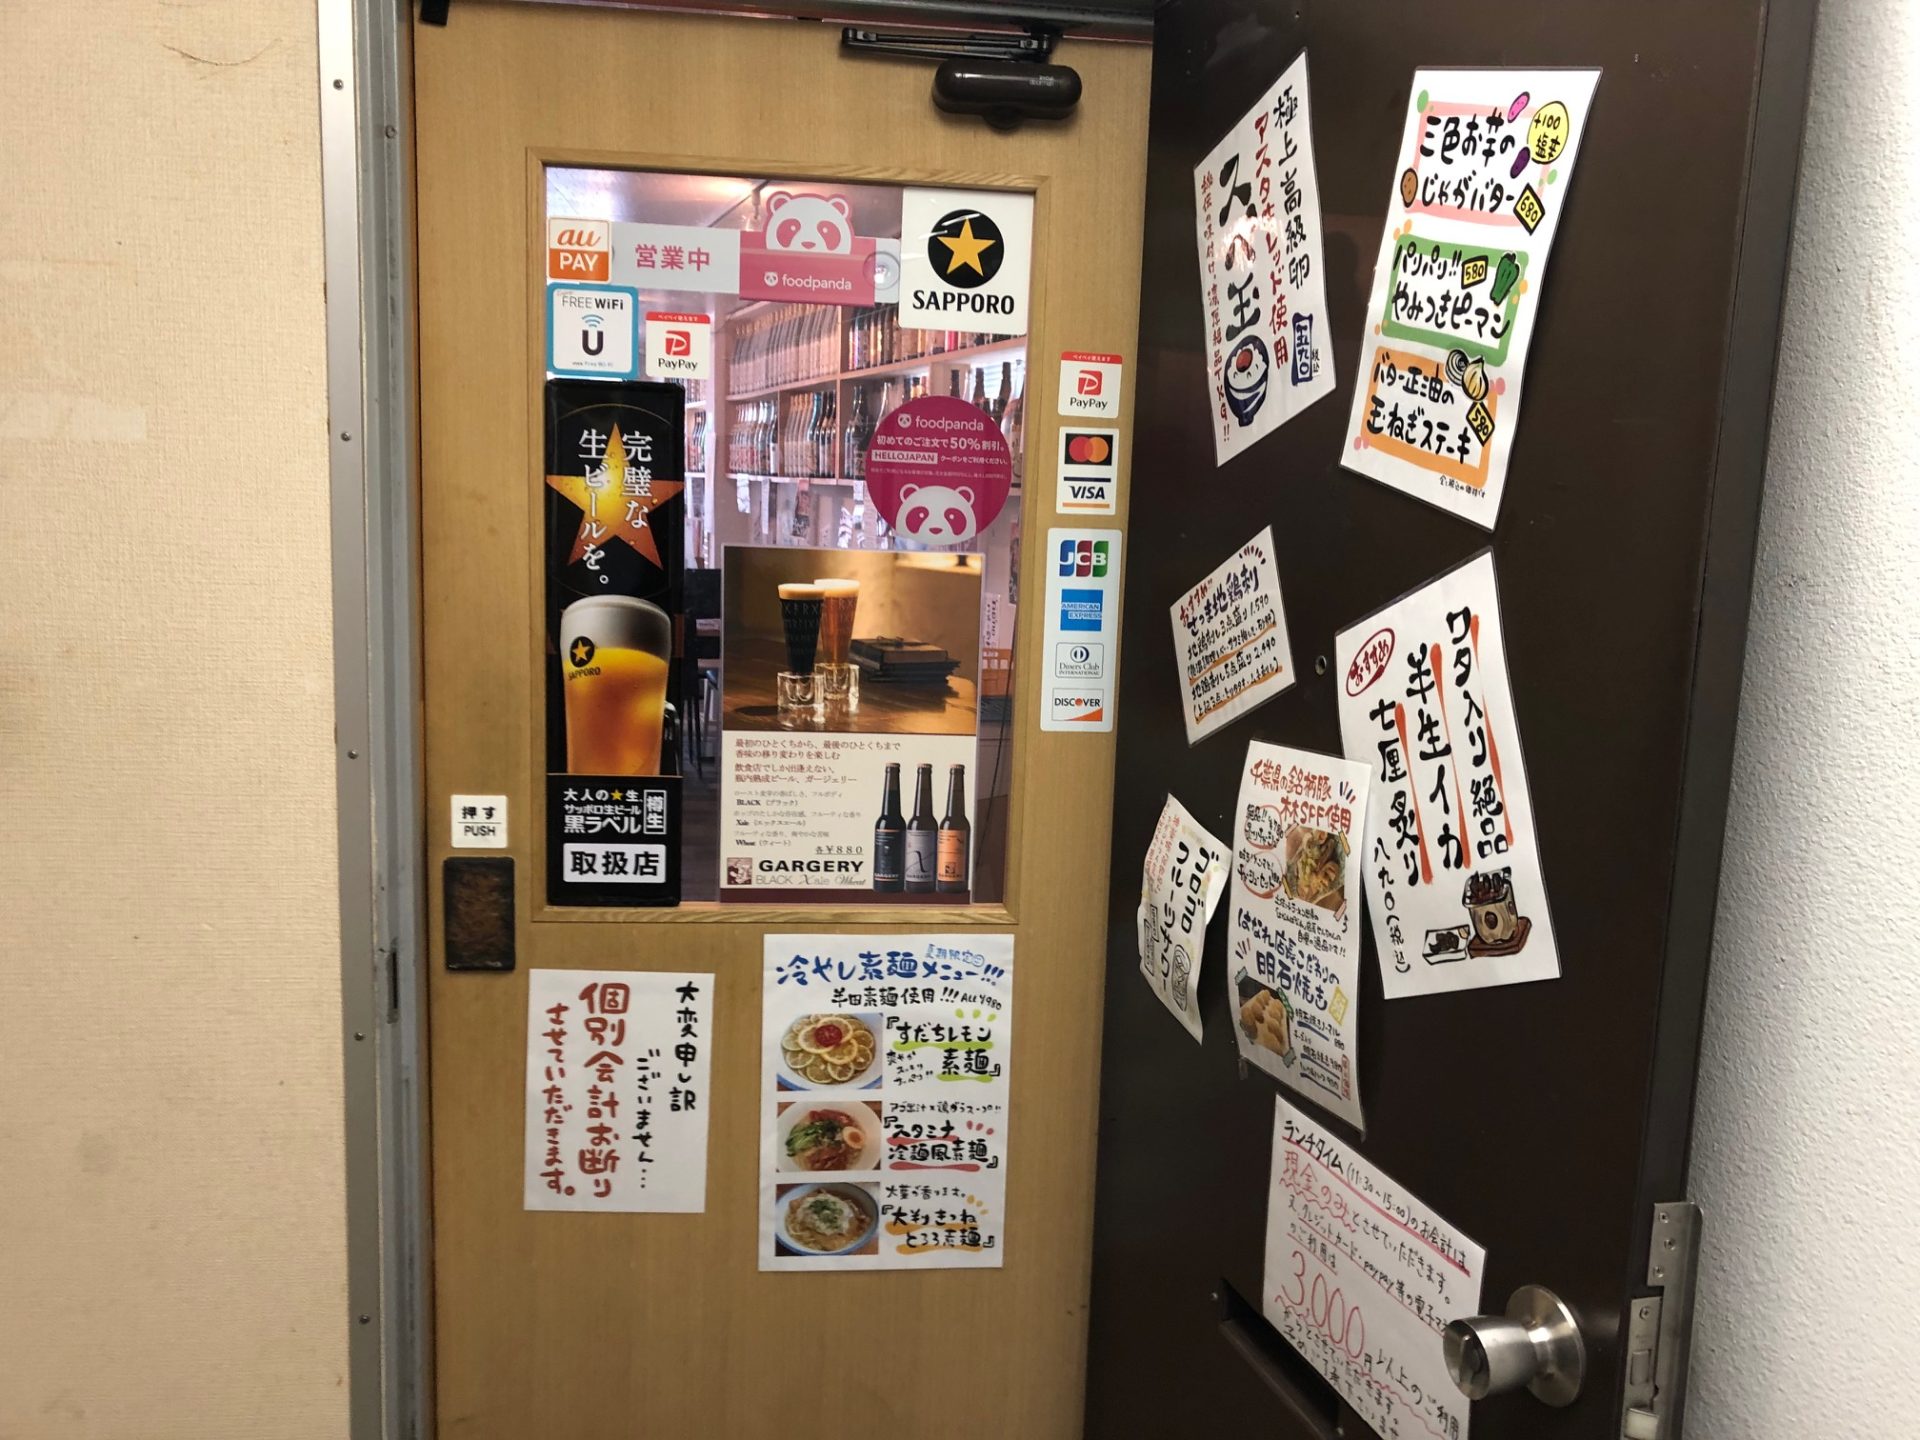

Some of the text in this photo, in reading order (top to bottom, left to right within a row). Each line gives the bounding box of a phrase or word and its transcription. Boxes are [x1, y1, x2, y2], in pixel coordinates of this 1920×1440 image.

[1534, 115, 1560, 130] +100
[1420, 107, 1515, 167] 三色お芋の
[1273, 85, 1310, 290] 極上高級卵
[1422, 170, 1515, 213] じゃがバター
[1520, 195, 1538, 222] 680
[557, 229, 601, 247] au
[559, 252, 598, 271] PAY
[635, 244, 710, 272] 営業中
[782, 273, 852, 291] foodpanda
[1465, 263, 1485, 281] 580
[562, 295, 624, 310] FREE WiFi
[913, 290, 1015, 315] SAPPORO
[1392, 281, 1510, 339] やみつきピーマン
[658, 358, 698, 371] PayPay
[1373, 352, 1454, 405] バター正油の
[1070, 397, 1108, 410] PayPay
[916, 416, 984, 432] foodpanda
[1367, 395, 1471, 464] 玉ねぎステーキ
[1472, 411, 1488, 437] 580
[874, 451, 935, 462] HELLOJAPAN
[622, 430, 653, 529] 完璧な
[1070, 486, 1105, 500] VISA
[578, 428, 609, 584] 生ビールを。
[1062, 603, 1100, 611] AMERICAN
[1068, 612, 1102, 620] EXPRESS
[568, 667, 600, 680] SAPPORO
[1059, 662, 1100, 671] Diners Club
[1350, 639, 1389, 686] おすすめ
[1055, 697, 1100, 707] DISCOVER
[1446, 606, 1509, 859] ワタ入り絶品
[1406, 643, 1463, 869] 半生イカ
[1369, 699, 1420, 886] 七厘炙り
[462, 805, 496, 820] 押す
[563, 803, 641, 815] サッポロ生ビール
[464, 825, 496, 836] PUSH
[563, 815, 641, 834] 黒ラベル
[570, 850, 660, 877] 取扱店
[758, 859, 864, 873] GARGERY
[755, 874, 793, 885] BLACK
[1181, 847, 1220, 934] ゴロゴロ
[1256, 950, 1328, 1010] 明石焼き
[669, 981, 700, 1112] 大変申し訳
[540, 1003, 576, 1195] させていただきます。
[578, 982, 630, 1198] 個別会計お断り
